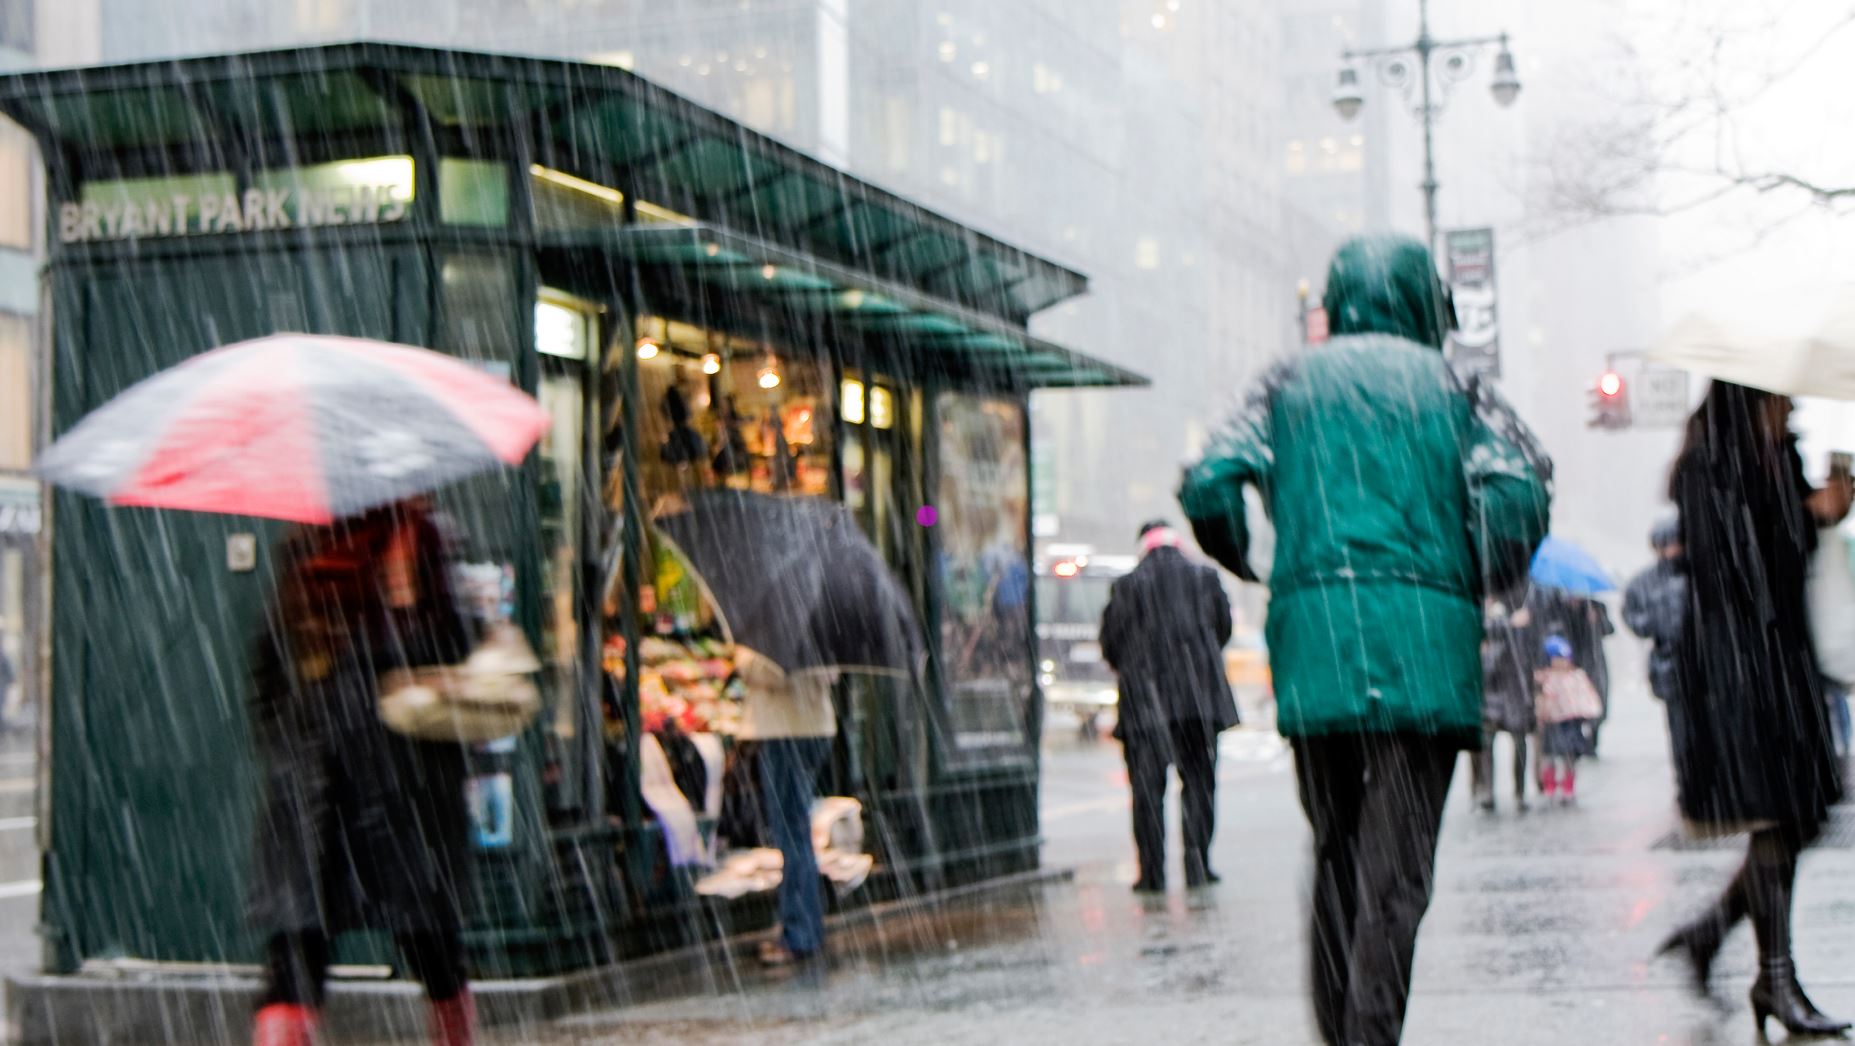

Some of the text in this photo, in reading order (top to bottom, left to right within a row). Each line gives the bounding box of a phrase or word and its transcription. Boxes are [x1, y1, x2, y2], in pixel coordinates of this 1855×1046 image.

[59, 183, 405, 243] BRYANT PARK NEWS
